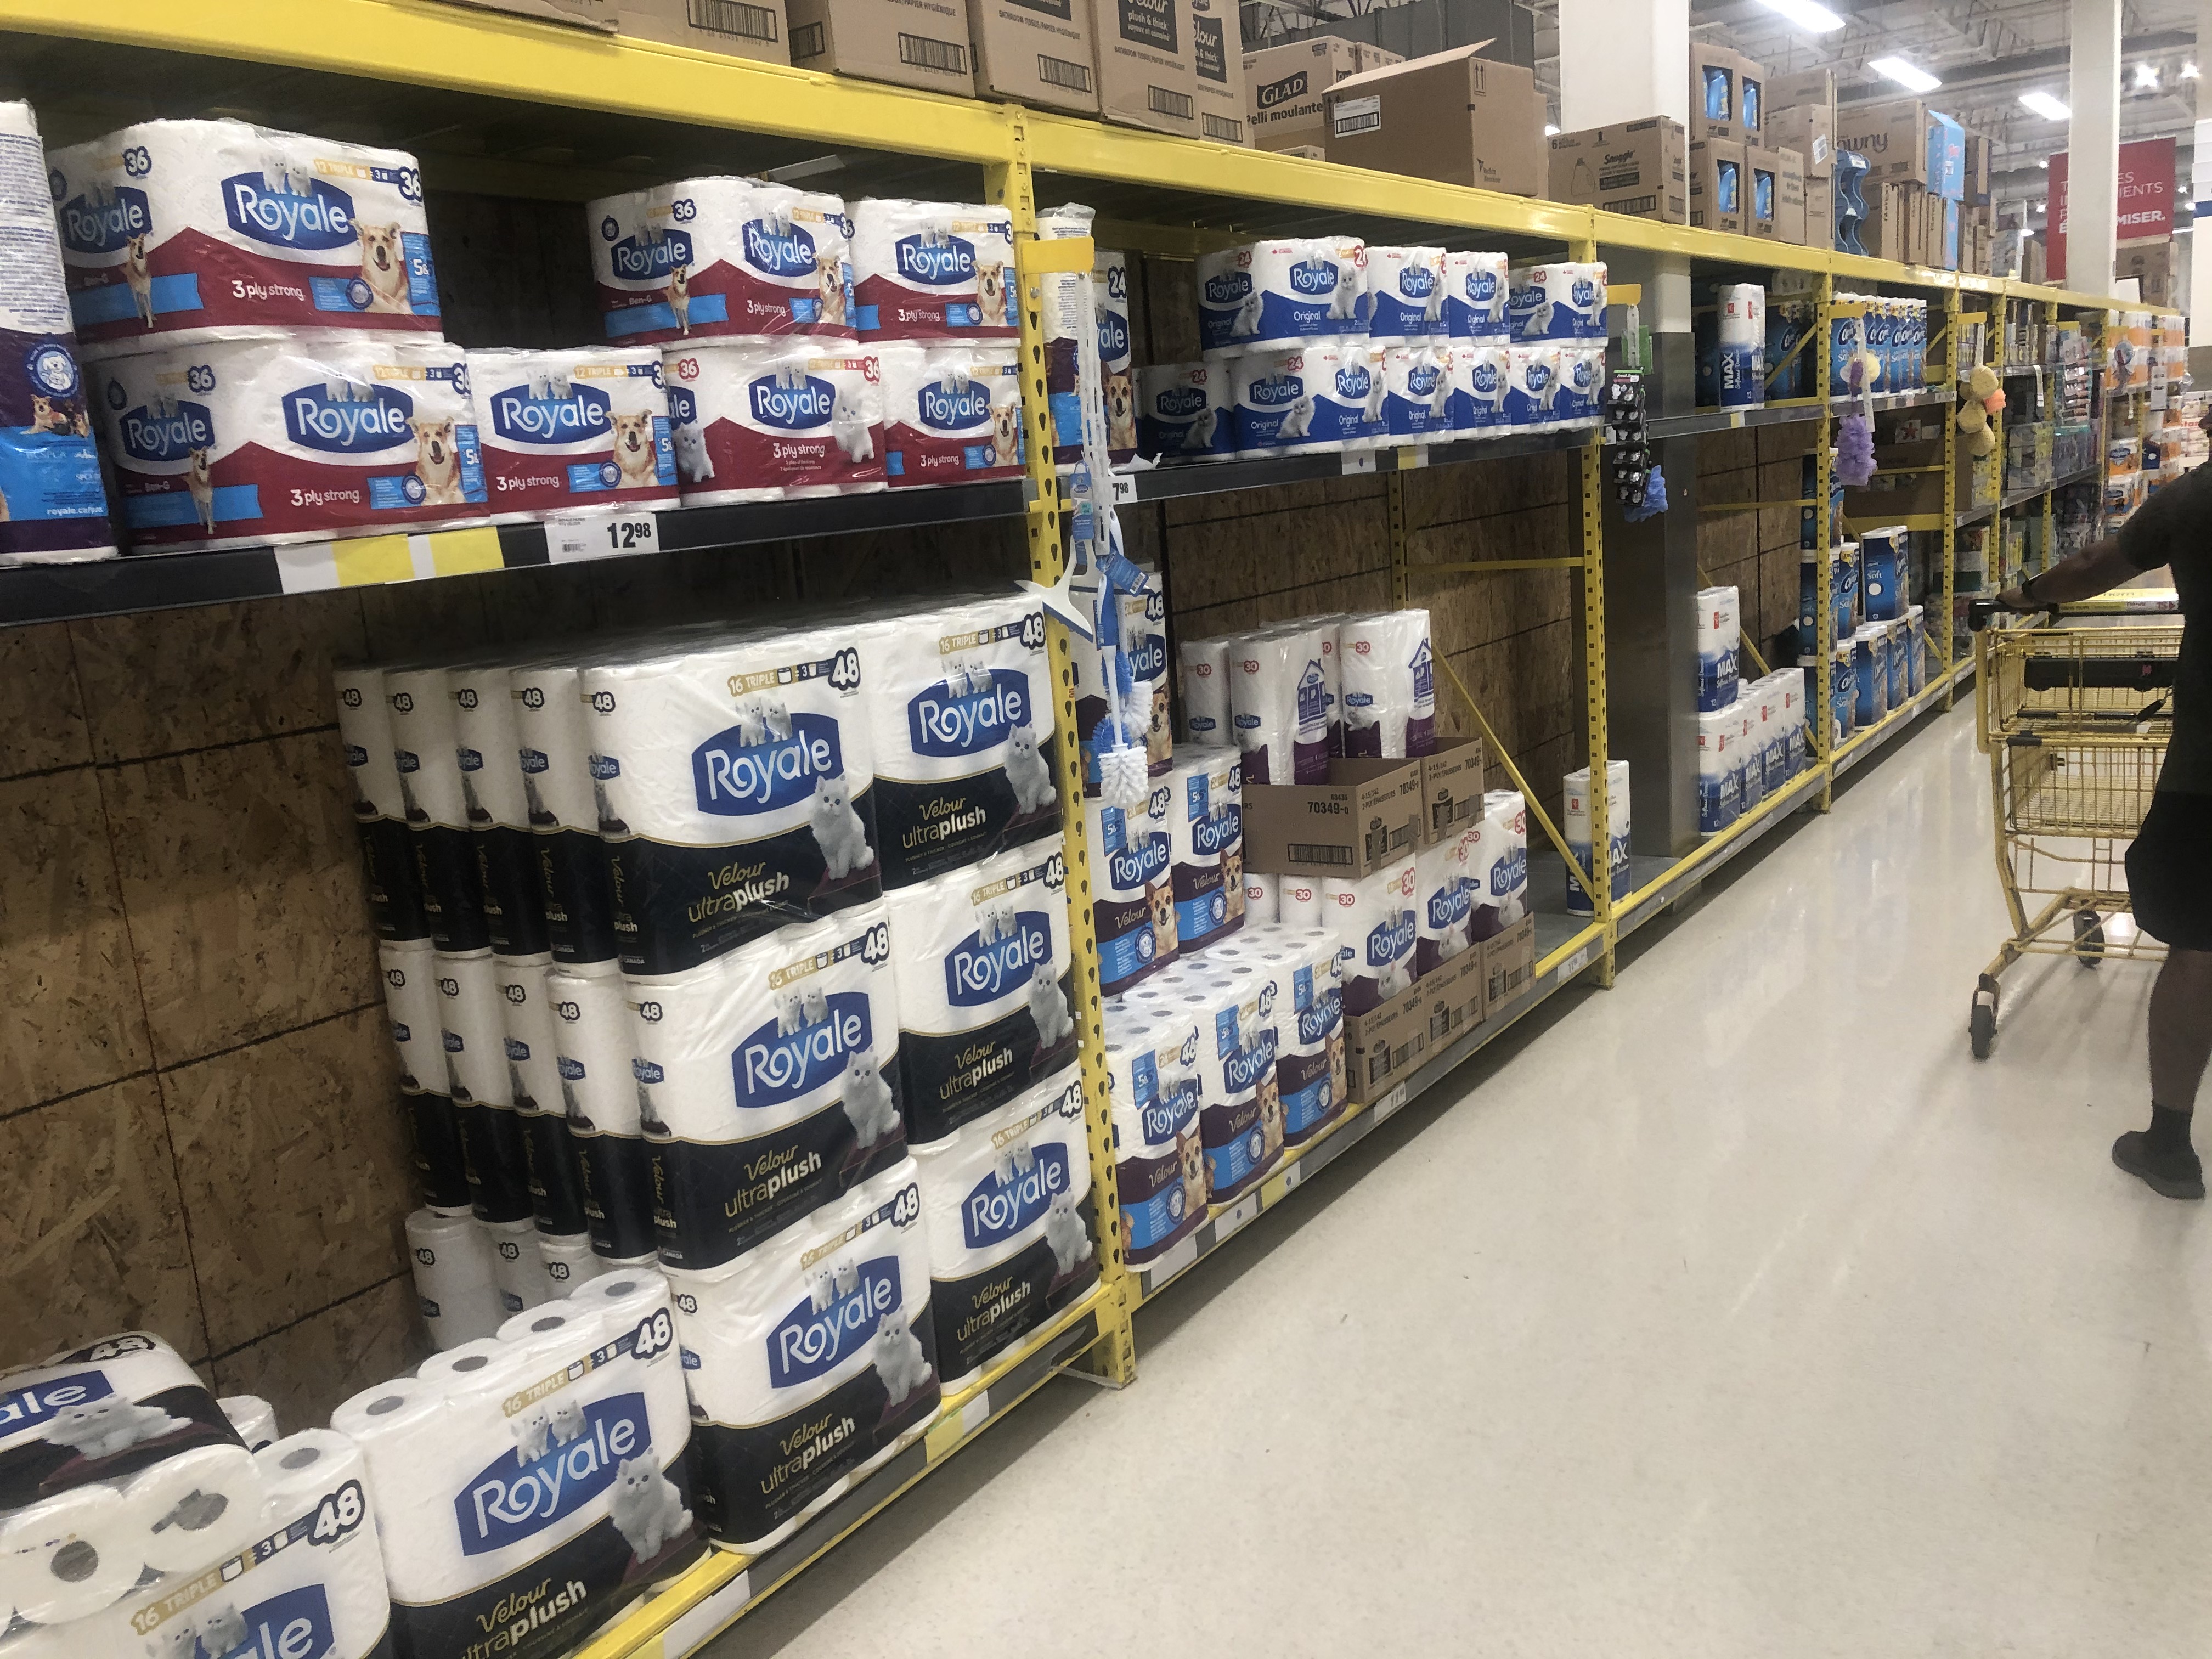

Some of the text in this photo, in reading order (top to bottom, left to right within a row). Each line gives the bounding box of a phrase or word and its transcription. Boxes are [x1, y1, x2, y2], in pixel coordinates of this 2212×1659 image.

[1152, 17, 1168, 31] thick
[1262, 78, 1304, 105] GLAD
[1271, 102, 1323, 121] moulante
[1551, 139, 1558, 149] 6
[1604, 149, 1635, 165] Snuggle
[235, 184, 351, 242] Royale
[674, 203, 695, 218] 36
[66, 201, 144, 247] Royale
[617, 242, 686, 275] Royale
[749, 230, 812, 272] Royale
[903, 244, 971, 280] Royale
[1109, 269, 1126, 295] 24
[1294, 268, 1334, 292] Royale
[1402, 273, 1433, 295] Royale
[1468, 278, 1495, 298] Royale
[1534, 272, 1545, 281] 24
[232, 280, 305, 302] 3 ply strong
[1209, 280, 1248, 301] Royale
[906, 308, 941, 322] ply strong
[1294, 311, 1321, 323] Original
[1400, 312, 1421, 324] Original
[680, 360, 698, 378] 36
[1193, 370, 1206, 382] 24
[1288, 358, 1304, 370] 24
[1722, 352, 1734, 390] MAX
[1253, 382, 1299, 404] Royale
[1338, 373, 1368, 396] Royale
[757, 390, 831, 426] Royale
[925, 392, 985, 422] Royale
[1160, 394, 1202, 412] Royale
[1408, 410, 1426, 421] Original
[295, 398, 405, 447] Royale
[500, 395, 605, 438] Royale
[1251, 420, 1278, 430] Original
[1339, 415, 1359, 426] Original
[128, 418, 207, 455] Royale
[773, 442, 826, 459] 3 ply strong
[921, 454, 960, 467] 3 ply strong
[290, 488, 360, 506] 3 ply strong
[497, 475, 560, 493] 3 ply strong
[1022, 617, 1045, 644] 48
[1356, 642, 1370, 652] 30
[745, 653, 861, 688] TRIPLE 48
[1130, 645, 1163, 676] yale
[1198, 665, 1211, 674] 30
[1245, 661, 1258, 672] 30
[1717, 653, 1737, 678] MAX
[460, 691, 475, 706] 48
[524, 690, 542, 706] 48
[595, 694, 613, 709] 48
[1347, 696, 1370, 706] Royale
[918, 688, 1023, 744] Royale
[1789, 729, 1804, 751] MAX
[1766, 743, 1783, 764] MAX
[704, 733, 833, 806] Royale
[1720, 773, 1739, 800] MAX
[918, 795, 967, 822] Velour
[1150, 791, 1165, 815] 48
[1307, 802, 1348, 814] 70349-0
[902, 808, 987, 851] ultraplush
[1197, 811, 1239, 849] Royale
[1115, 843, 1166, 883] Royale
[1612, 840, 1628, 866] AX
[707, 860, 767, 891] Velour
[1045, 856, 1065, 885] 48
[1193, 872, 1220, 890] Velour
[1402, 869, 1415, 893] 30
[1493, 854, 1526, 889] Royale
[687, 870, 790, 926] ultraplush
[1249, 889, 1261, 898] 30
[1296, 890, 1311, 899] 30
[1340, 895, 1353, 905] 30
[1432, 887, 1469, 922] Royale
[1115, 906, 1147, 929] Velour
[863, 927, 890, 960] 48
[1371, 919, 1414, 960] Royale
[954, 930, 1044, 996] Royale
[561, 1003, 578, 1018] 48
[642, 1003, 660, 1018] 48
[1302, 996, 1341, 1037] Royale
[745, 1010, 862, 1101] Royale
[954, 1041, 997, 1070] Velour
[1228, 1039, 1273, 1086] Royale
[939, 1047, 1013, 1100] ultraplush
[1301, 1060, 1327, 1080] Velour
[1060, 1085, 1083, 1113] 48
[1147, 1092, 1195, 1138] Royale
[1229, 1107, 1257, 1131] Velour
[743, 1145, 799, 1182] Velour
[1149, 1161, 1178, 1187] Velour
[724, 1150, 823, 1220] ultraplush
[971, 1163, 1062, 1228] Royale
[891, 1187, 919, 1223] 48
[679, 1296, 695, 1310] 48
[972, 1275, 1013, 1309] Velour
[957, 1278, 1031, 1344] ultraplush
[780, 1276, 893, 1375] Royale
[526, 1314, 672, 1403] TRIPLE 48
[0, 1384, 86, 1421] ale
[779, 1413, 834, 1457] Velour
[760, 1415, 856, 1496] ultraplush
[472, 1417, 636, 1539] Royale
[135, 1487, 362, 1630] 16 TRIPLE 48
[476, 1578, 551, 1633] Velour
[462, 1580, 587, 1659] ltraplush
